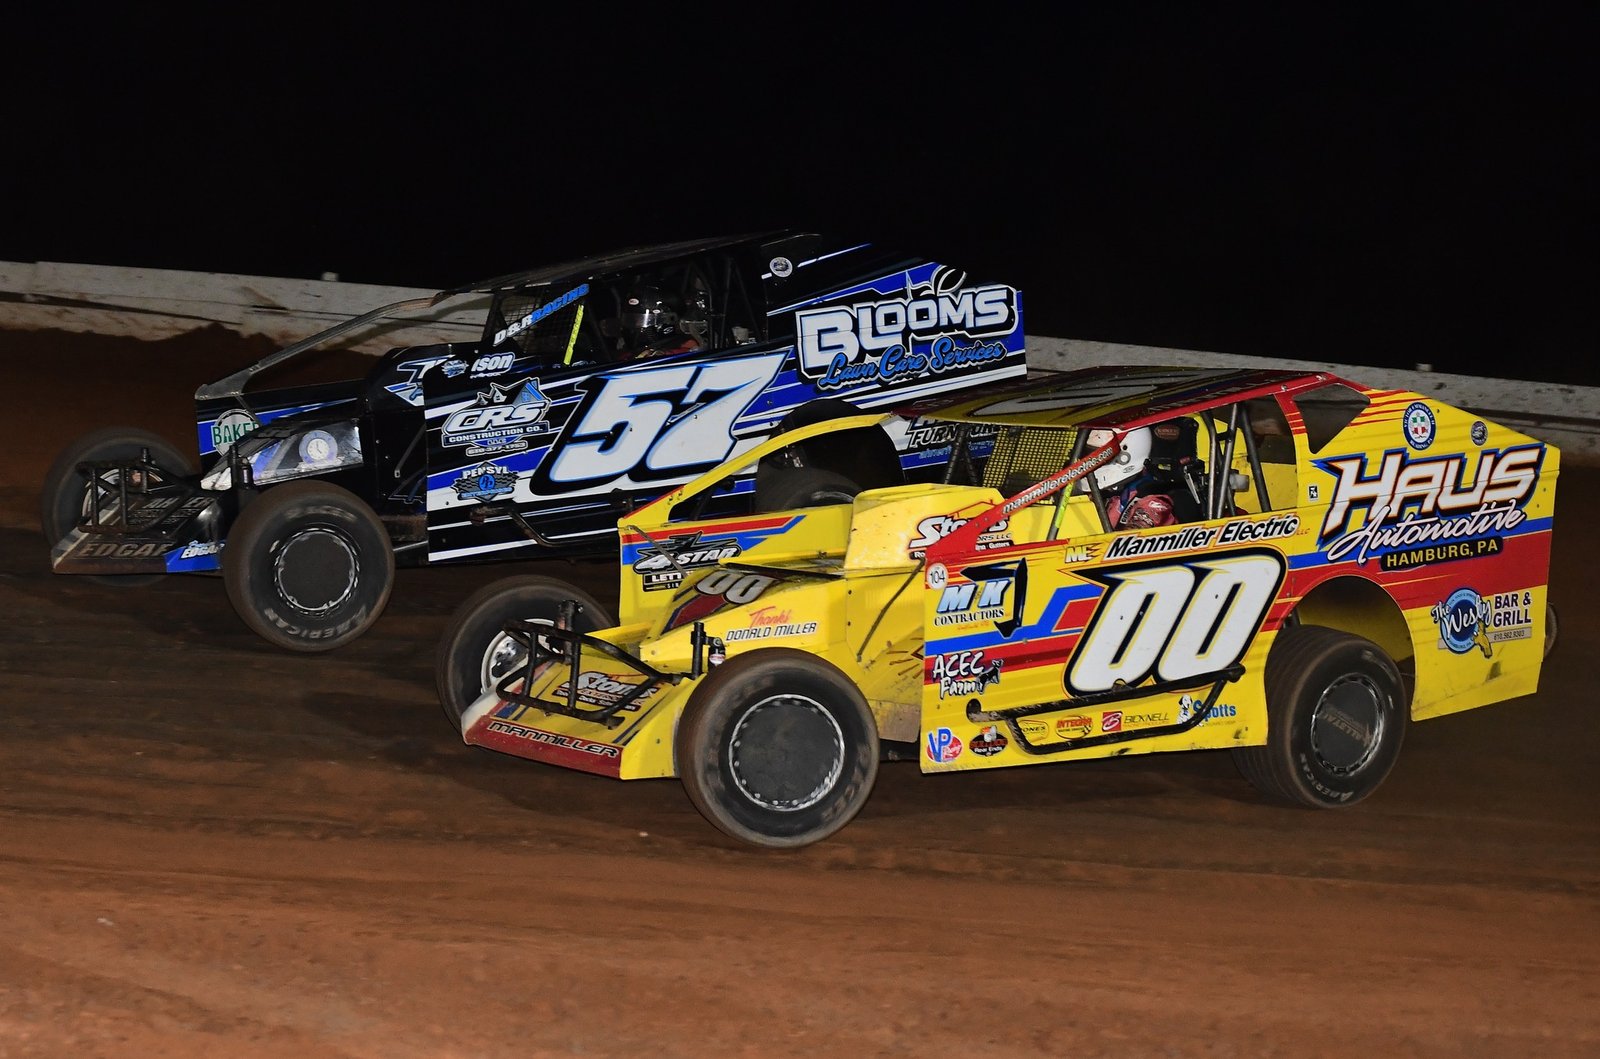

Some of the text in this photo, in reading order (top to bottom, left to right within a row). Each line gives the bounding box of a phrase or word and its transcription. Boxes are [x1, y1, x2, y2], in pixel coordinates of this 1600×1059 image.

[531, 284, 590, 323] RACING
[799, 288, 1012, 370] BLOOMS
[818, 336, 1007, 389] Lawn Care Services
[446, 402, 545, 432] CRS
[449, 427, 523, 442] CONSTRUCTION
[547, 350, 792, 484] 57
[1002, 446, 1113, 514] manmillerelectric.com
[1319, 447, 1542, 538] HAUS
[1106, 527, 1217, 560] Manmiller
[1218, 516, 1299, 542] Electric
[1326, 499, 1527, 565] Automotive
[677, 547, 738, 565] STAR
[1386, 539, 1498, 567] HAMBURG, PA
[696, 569, 777, 605] 00
[930, 571, 946, 584] 104
[934, 608, 1004, 627] CONTRACTORS
[1493, 609, 1532, 628] GRILL
[1494, 593, 1519, 610] BAR
[1522, 592, 1531, 606] &
[726, 622, 817, 642] DONALD MILLER
[1068, 552, 1283, 694] 00
[487, 721, 619, 758] MANMILLER
[928, 727, 951, 762] VP
